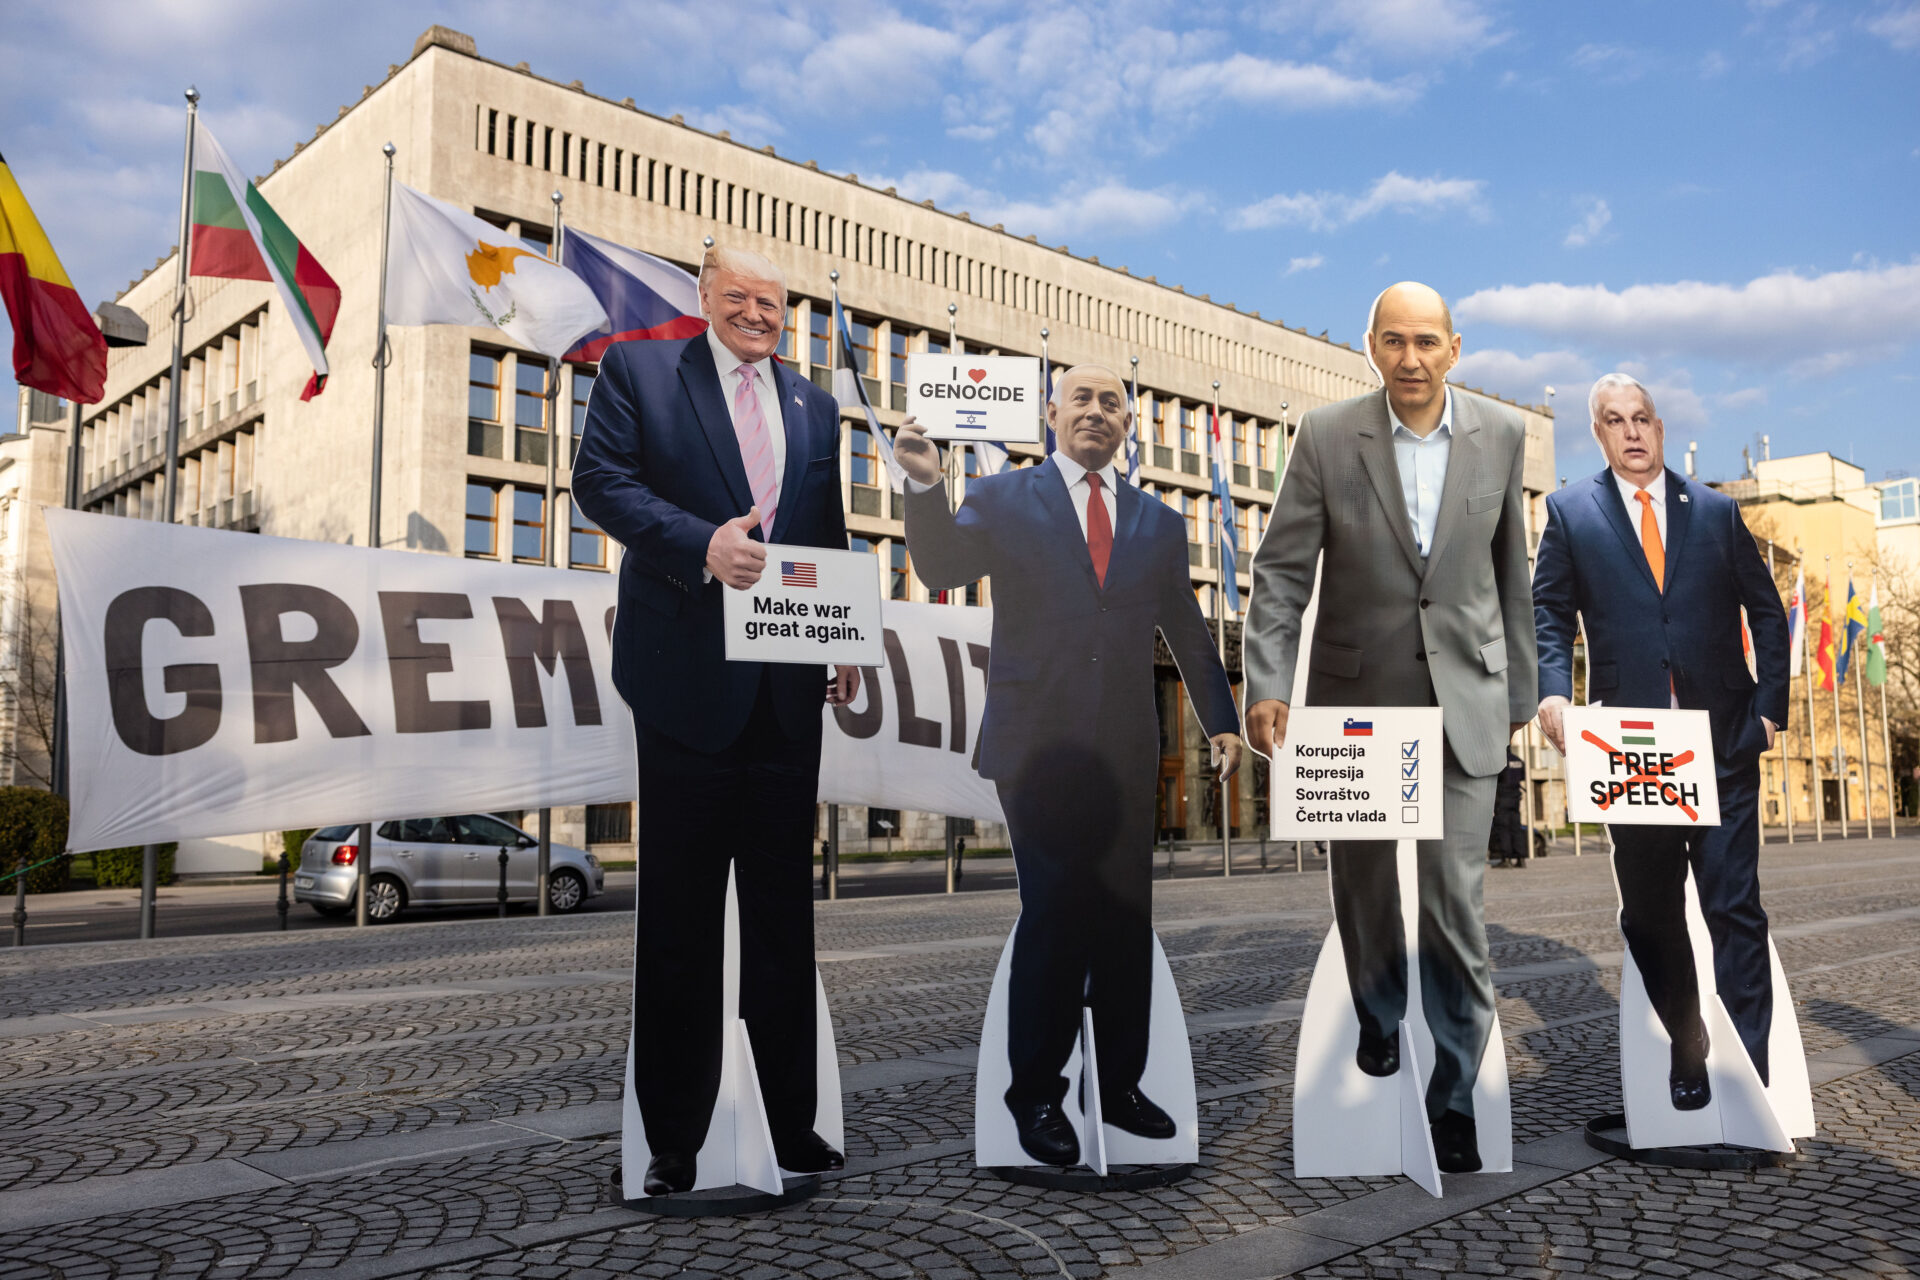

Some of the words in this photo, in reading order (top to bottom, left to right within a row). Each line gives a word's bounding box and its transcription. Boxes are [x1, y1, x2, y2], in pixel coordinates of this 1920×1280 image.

[953, 366, 957, 380] I
[919, 382, 1024, 402] GENOCIDE
[753, 596, 809, 617] Make
[814, 604, 851, 619] war
[745, 621, 800, 640] great
[805, 622, 865, 643] again.
[104, 583, 618, 756] GREM
[1295, 744, 1365, 760] Korupcija
[1295, 766, 1364, 781] Represija
[1608, 751, 1675, 776] FREE
[1295, 788, 1370, 801] Sovraštvo
[1590, 780, 1699, 806] SPEECH
[1295, 806, 1343, 823] Četrta
[1347, 810, 1387, 823] vlada
